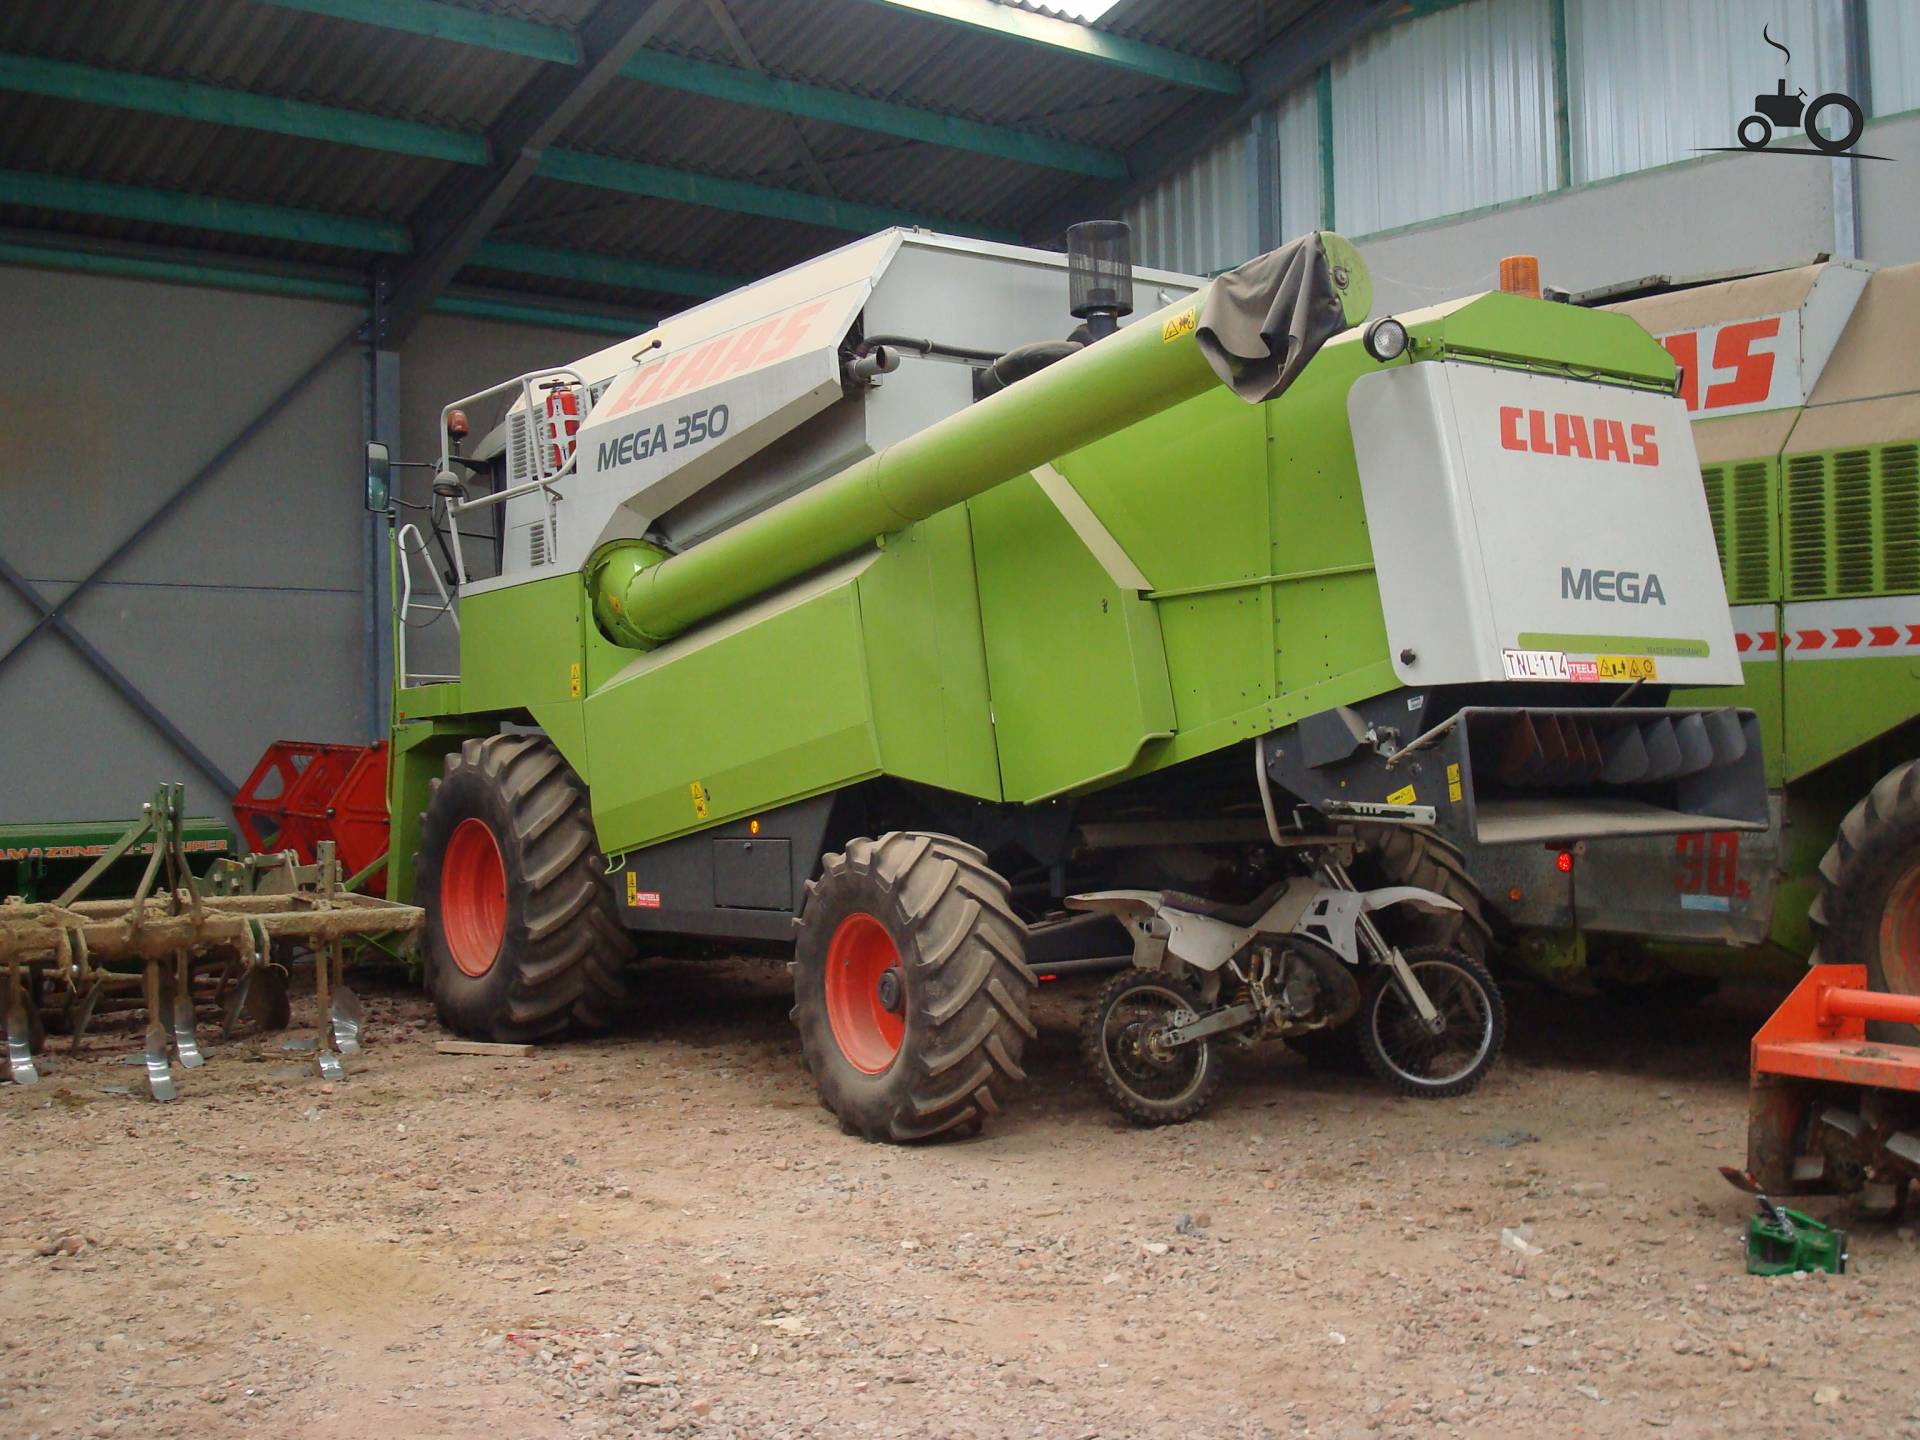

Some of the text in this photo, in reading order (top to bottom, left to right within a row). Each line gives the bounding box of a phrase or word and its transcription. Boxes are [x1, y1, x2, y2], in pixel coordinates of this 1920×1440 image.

[605, 300, 829, 417] CLAAS
[597, 404, 729, 472] MEGA 350
[1500, 406, 1659, 466] CLAAS
[1561, 567, 1666, 605] MEGA
